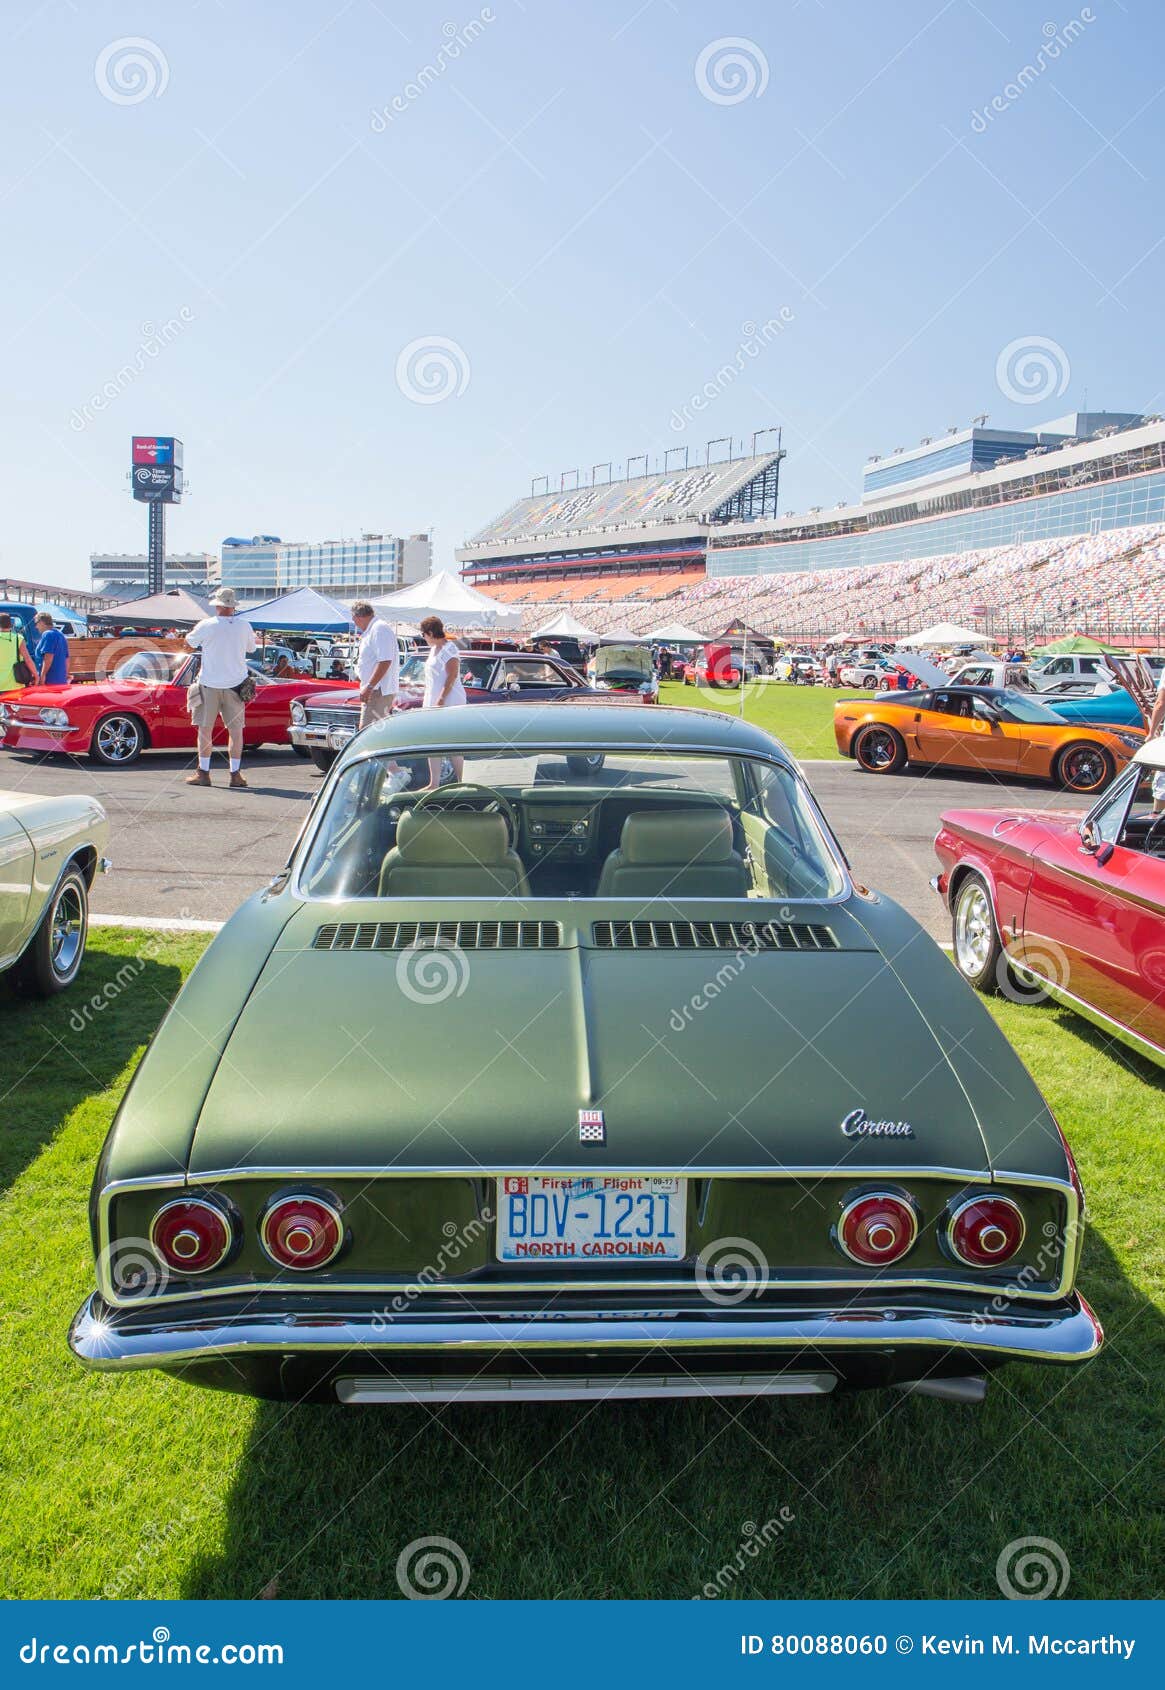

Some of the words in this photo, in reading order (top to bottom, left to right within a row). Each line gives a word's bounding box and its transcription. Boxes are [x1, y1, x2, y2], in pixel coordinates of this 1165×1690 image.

[841, 1108, 913, 1136] Corvair
[542, 1178, 572, 1190] First
[581, 1178, 593, 1189] in
[603, 1178, 642, 1191] Flight
[509, 1194, 676, 1238] BDV-1231
[516, 1242, 575, 1256] NORTH
[582, 1242, 666, 1255] CAROLINA
